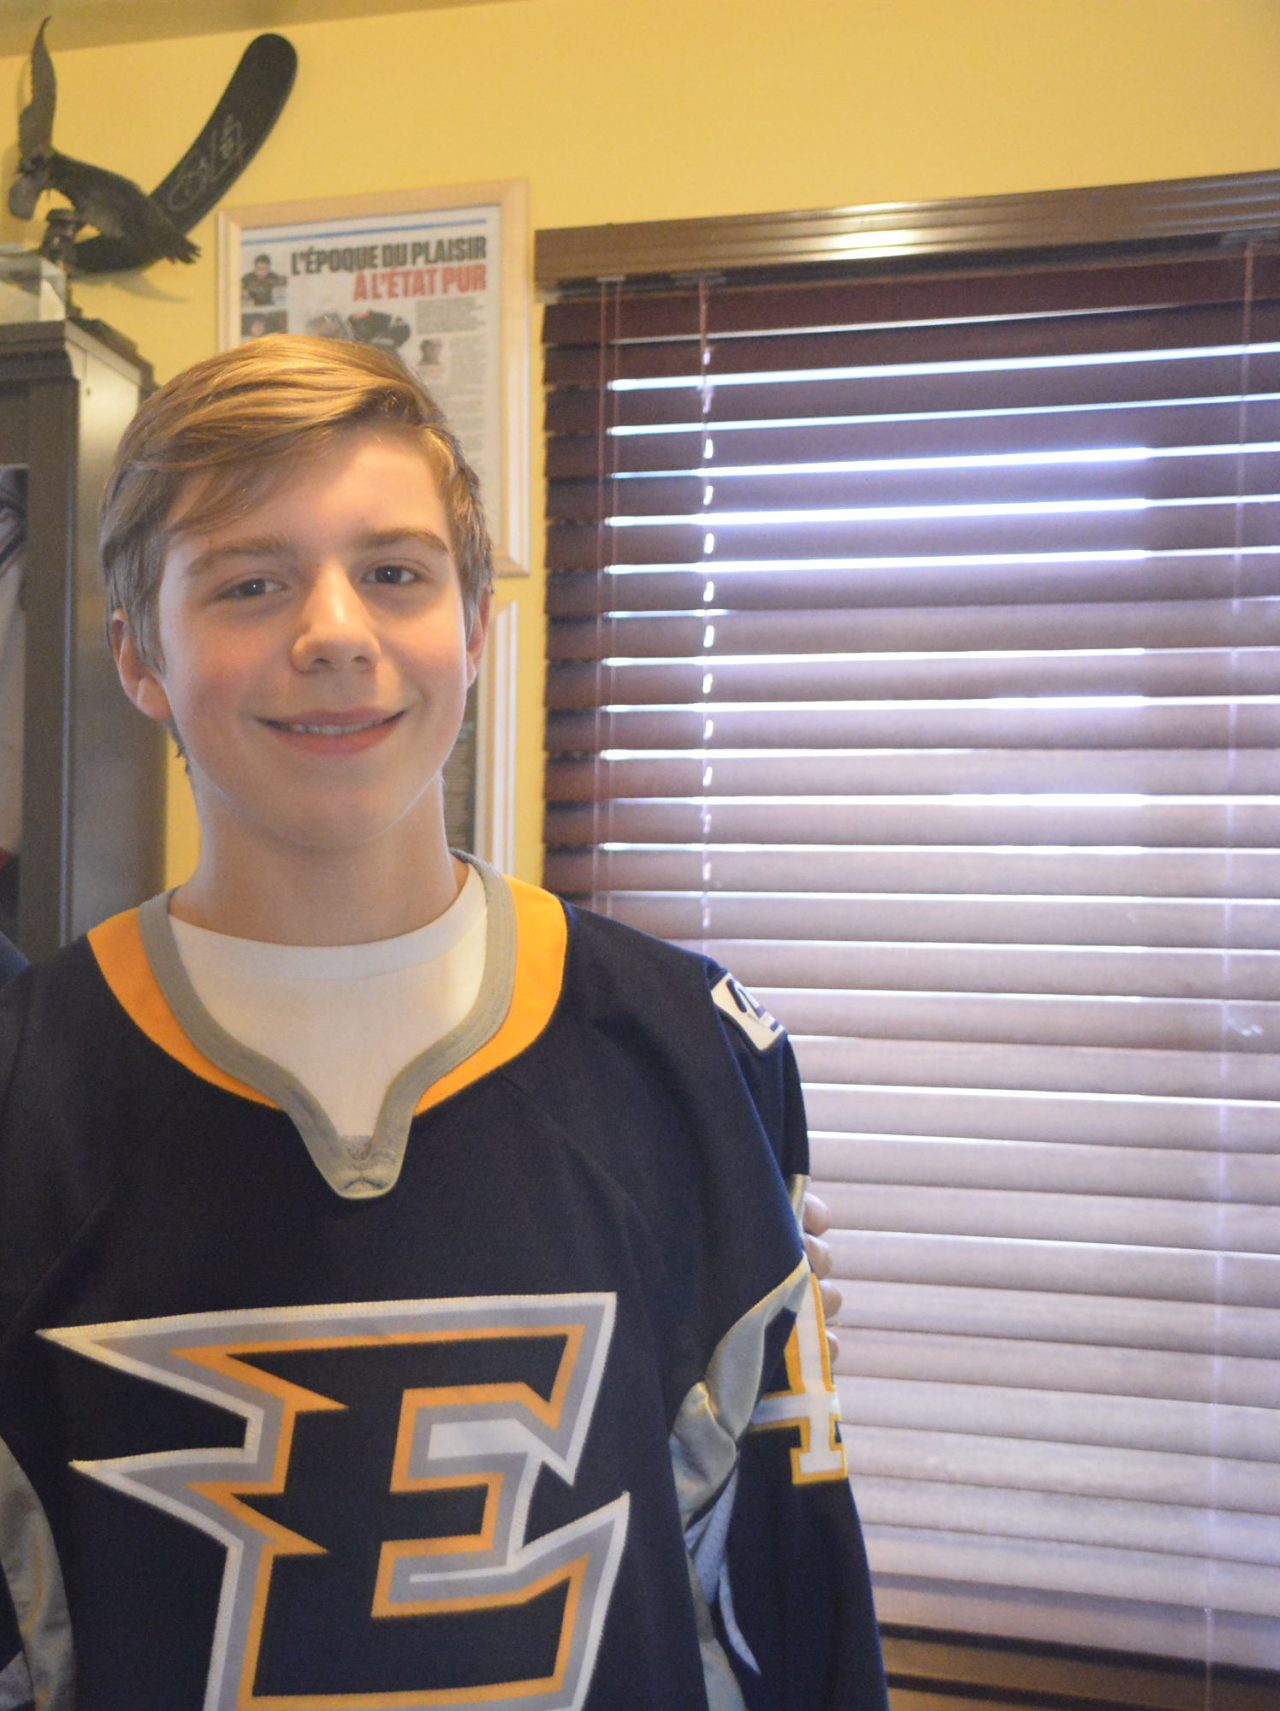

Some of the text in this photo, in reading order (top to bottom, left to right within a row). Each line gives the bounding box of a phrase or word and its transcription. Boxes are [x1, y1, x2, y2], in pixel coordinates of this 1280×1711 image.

[291, 236, 487, 276] L'ÉPOQUE DU PLAISIR
[372, 263, 437, 299] L'ÉTAT
[442, 264, 487, 294] PUR
